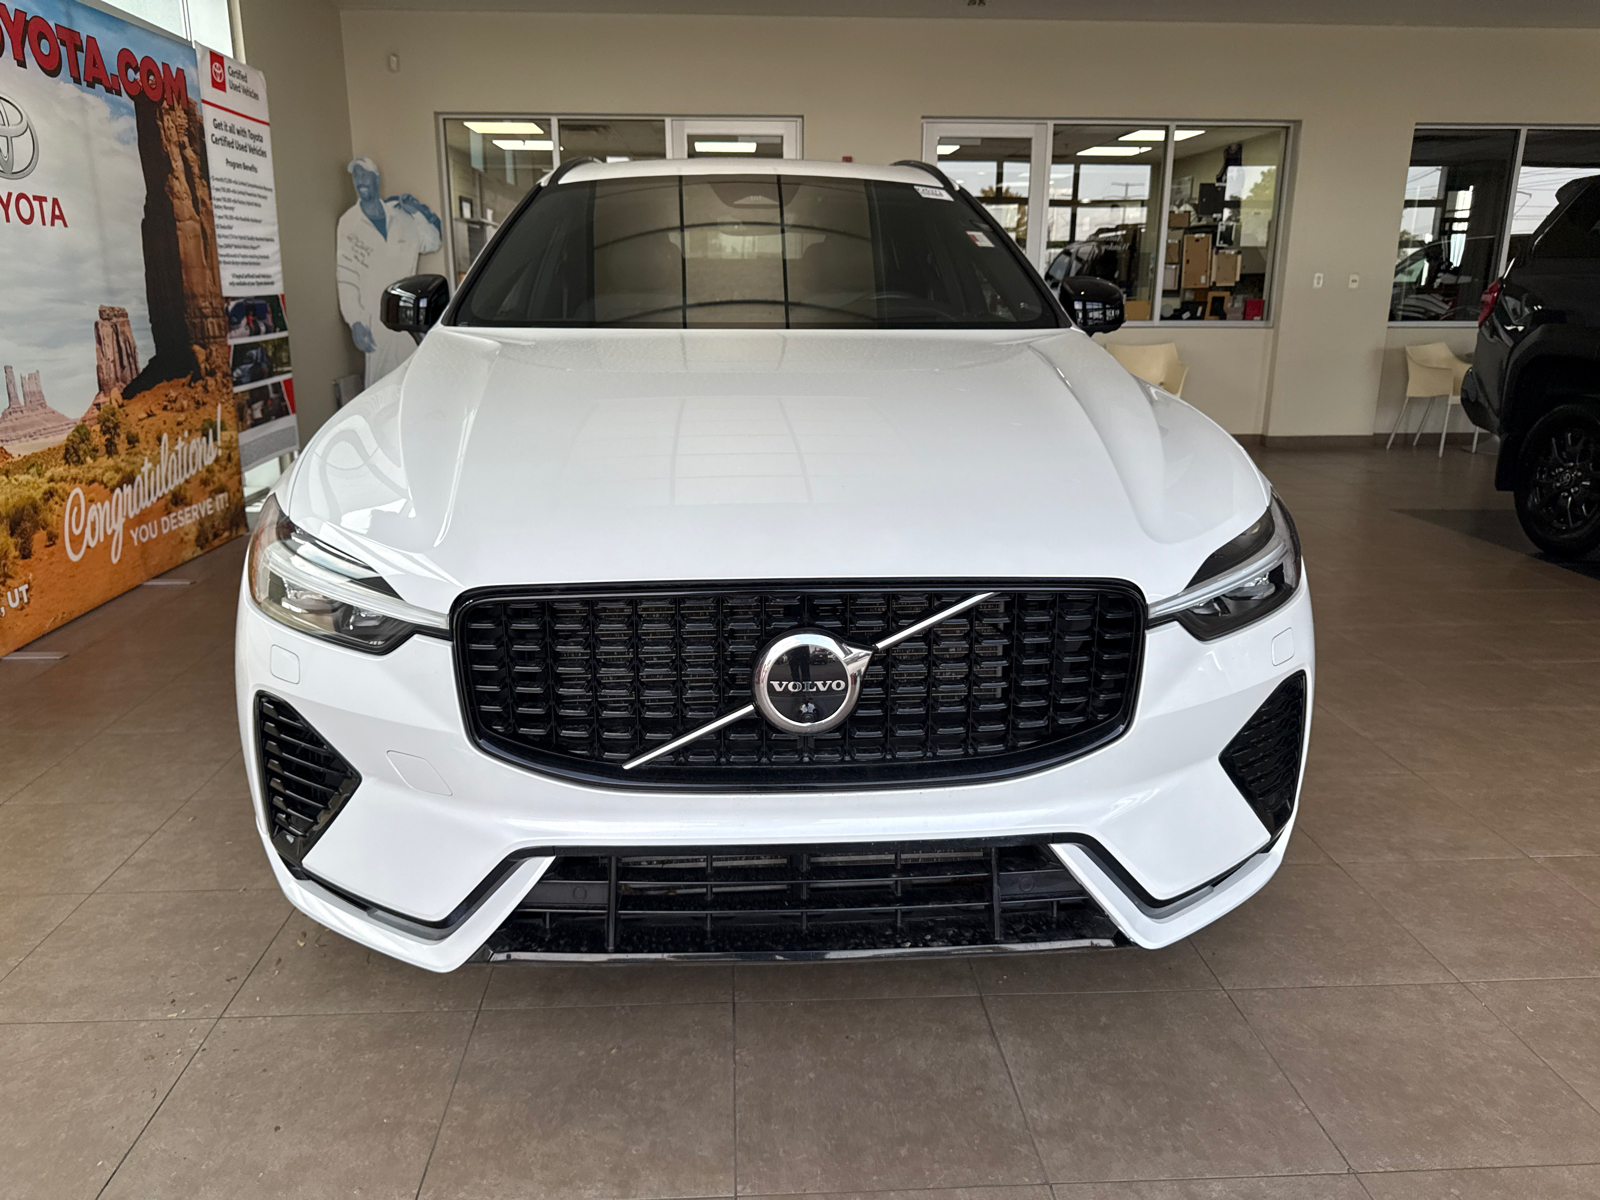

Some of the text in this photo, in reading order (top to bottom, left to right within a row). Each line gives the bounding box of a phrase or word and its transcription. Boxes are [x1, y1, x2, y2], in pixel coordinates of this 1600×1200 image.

[0, 2, 189, 110] YOTA.COM
[228, 66, 248, 83] Certified
[229, 80, 260, 101] Used Vehicles
[213, 118, 223, 131] Get
[223, 121, 229, 132] it
[236, 126, 247, 138] with
[247, 129, 264, 144] Toyota
[211, 133, 268, 158] Certified Used Vehicles
[225, 158, 259, 174] Program Benefits
[64, 403, 223, 565] Congratulations!
[130, 491, 230, 547] YOU DESERVE IT!
[7, 583, 29, 609] UT
[770, 680, 846, 692] VOLVO
